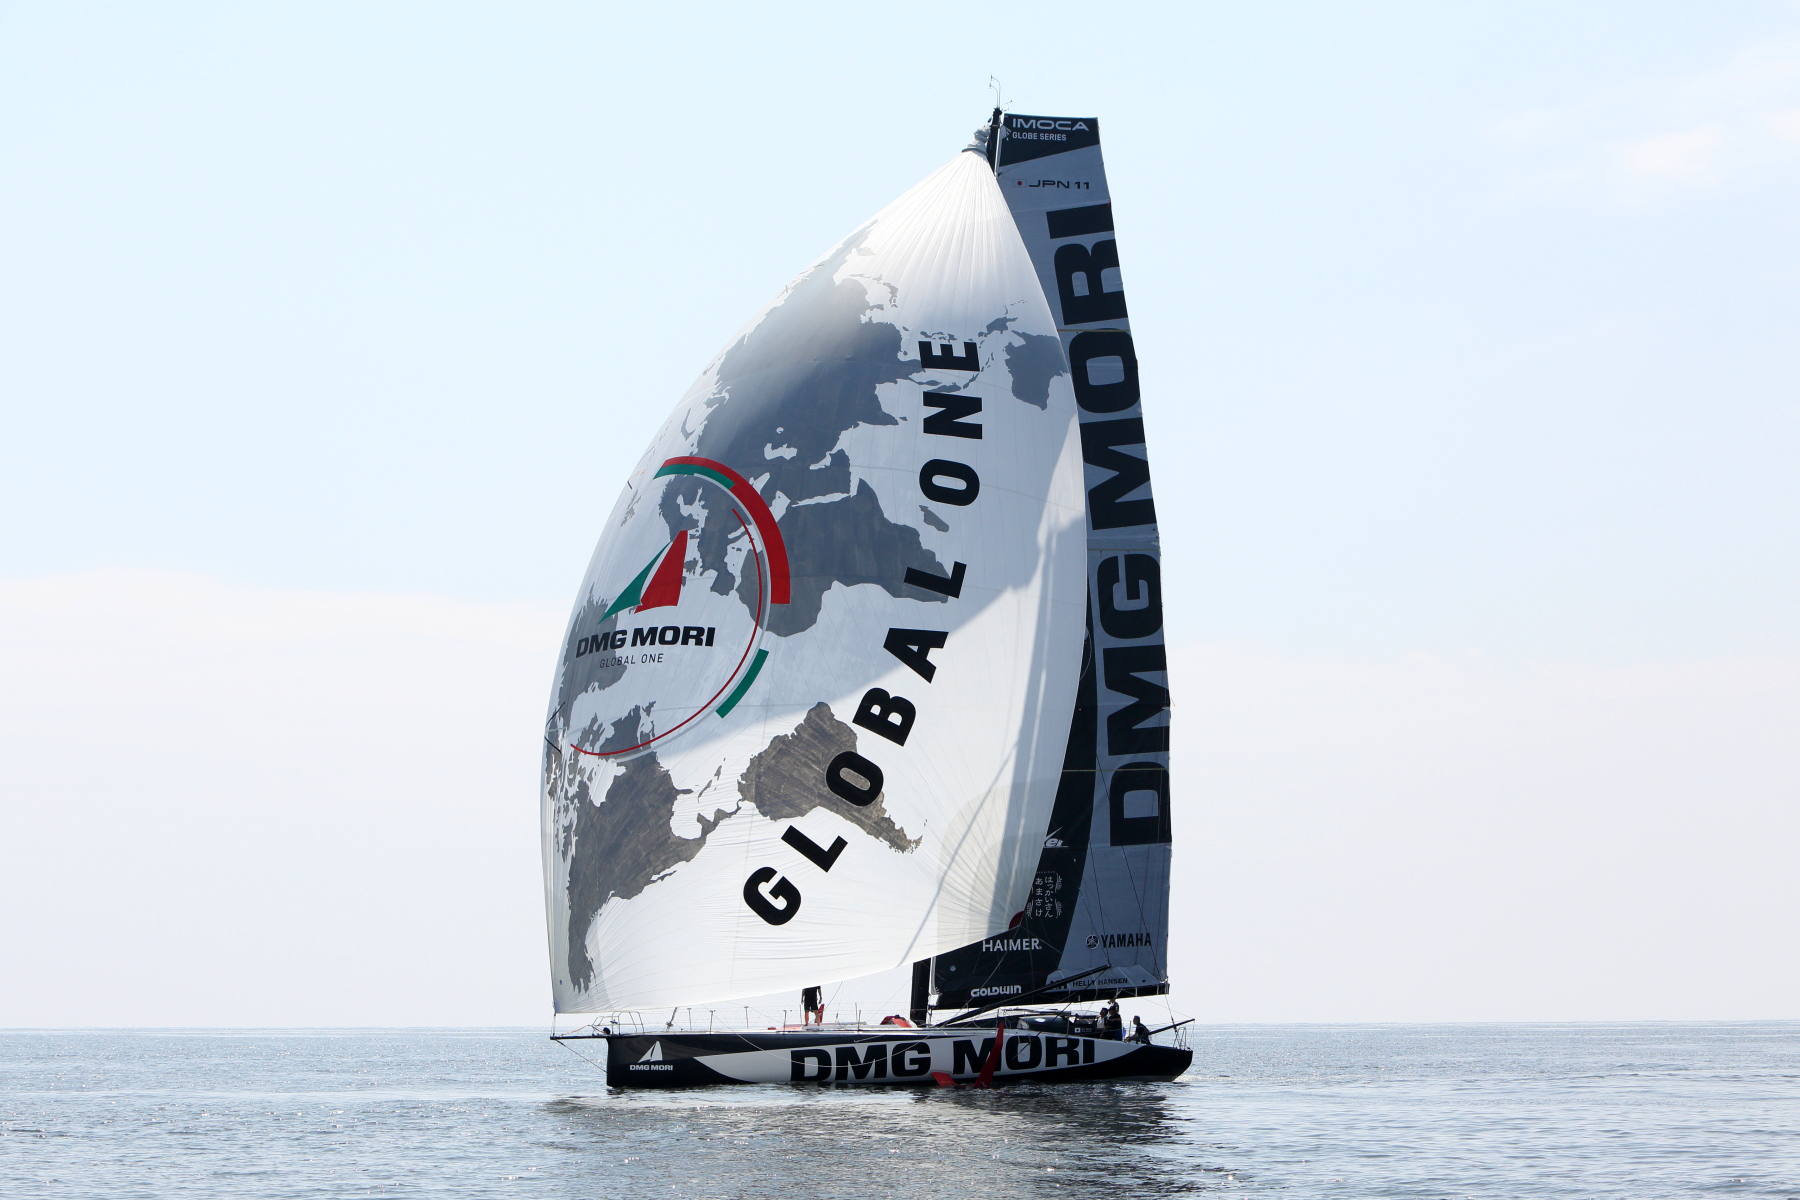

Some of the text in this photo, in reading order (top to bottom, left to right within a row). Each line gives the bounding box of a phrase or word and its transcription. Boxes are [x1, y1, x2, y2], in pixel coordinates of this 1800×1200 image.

[1012, 118, 1089, 131] IMOCA
[1012, 132, 1067, 141] GLOBE SERIES
[1028, 180, 1090, 190] JPN 11
[1046, 203, 1172, 846] DMG MORI
[743, 341, 983, 926] GLOBAL ONE
[576, 626, 716, 658] DMG MORI
[600, 653, 664, 668] GLOBAL ONE
[982, 938, 1040, 952] HAIMER
[1101, 932, 1151, 948] YAMAHA
[1072, 980, 1096, 988] HELLY
[1098, 977, 1128, 986] HANSEN
[790, 1035, 1096, 1083] DMG MORI
